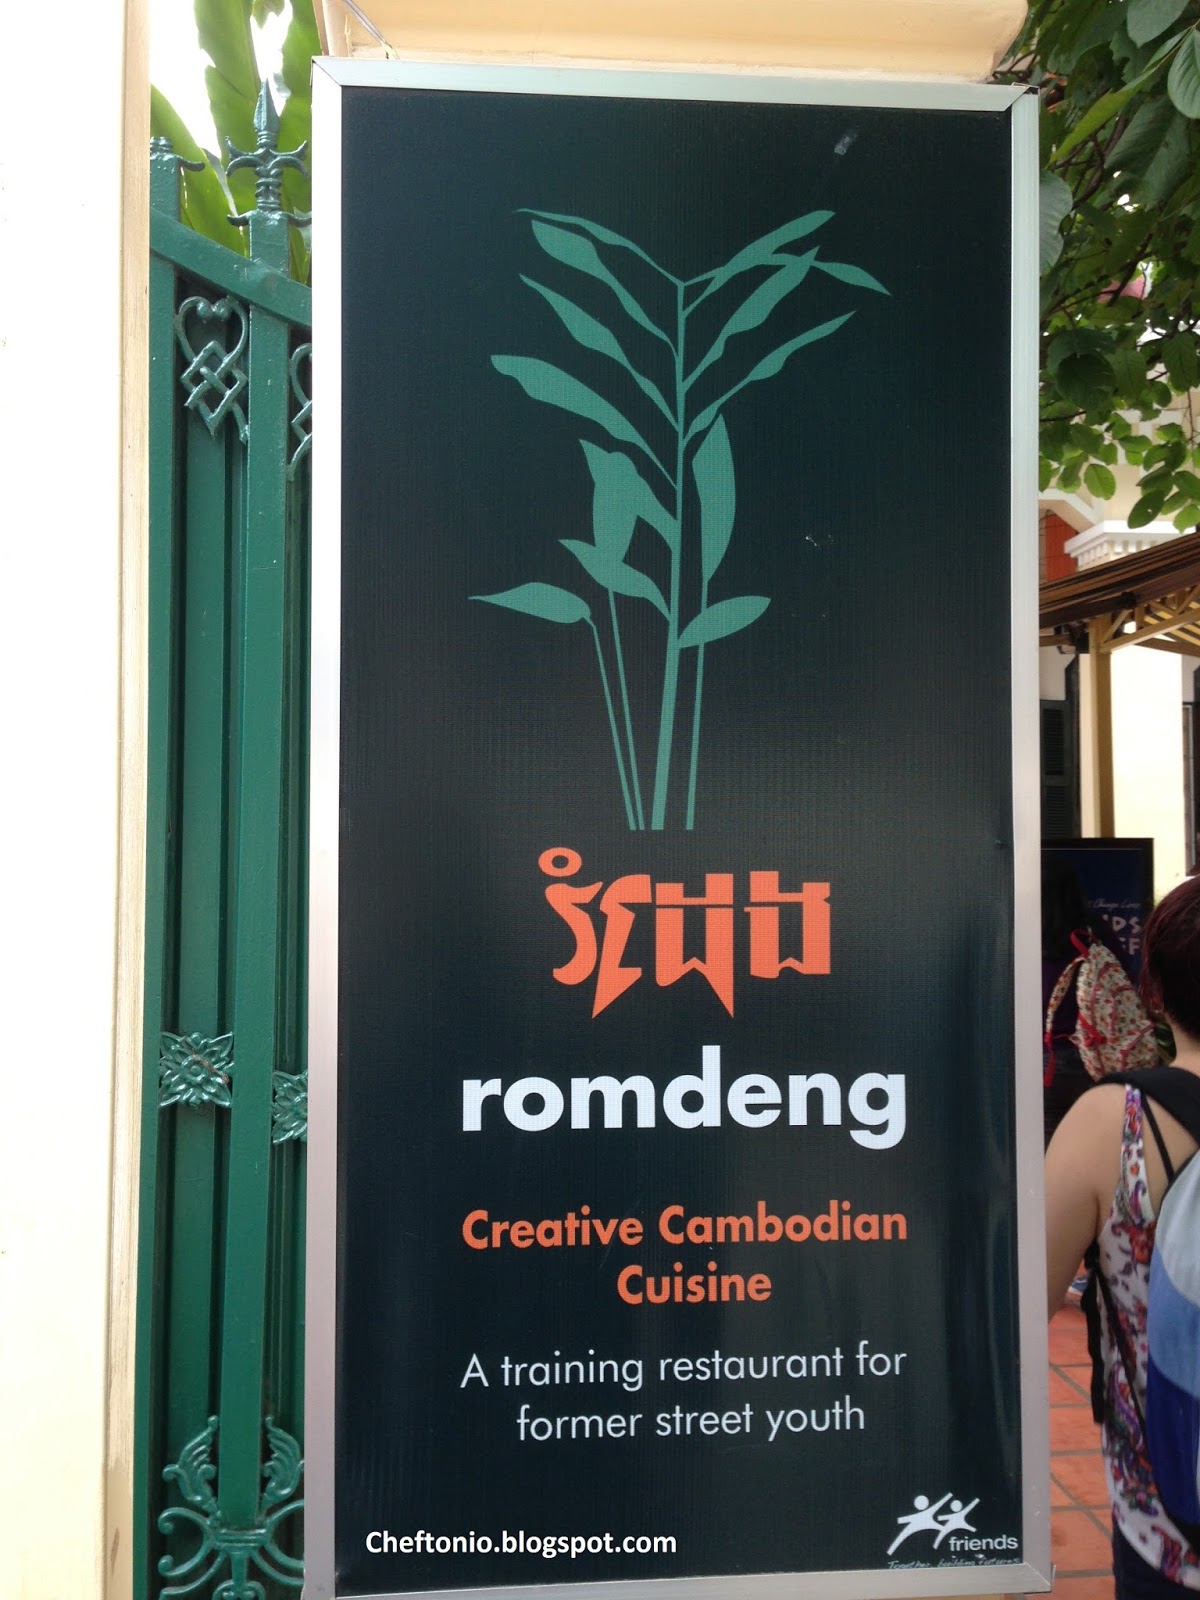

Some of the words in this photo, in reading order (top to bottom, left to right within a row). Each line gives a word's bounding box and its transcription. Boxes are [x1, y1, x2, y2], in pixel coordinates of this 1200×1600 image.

[462, 1045, 906, 1150] romdeng
[462, 1205, 643, 1250] Creative
[659, 1200, 907, 1245] Cambodian
[617, 1261, 772, 1305] Cuisine
[460, 1353, 489, 1388] A
[501, 1349, 643, 1392] training
[659, 1347, 844, 1381] restaurant
[856, 1340, 907, 1377] for
[517, 1404, 642, 1441] former
[656, 1403, 753, 1436] street
[766, 1395, 865, 1442] youth
[948, 1534, 1019, 1552] friends
